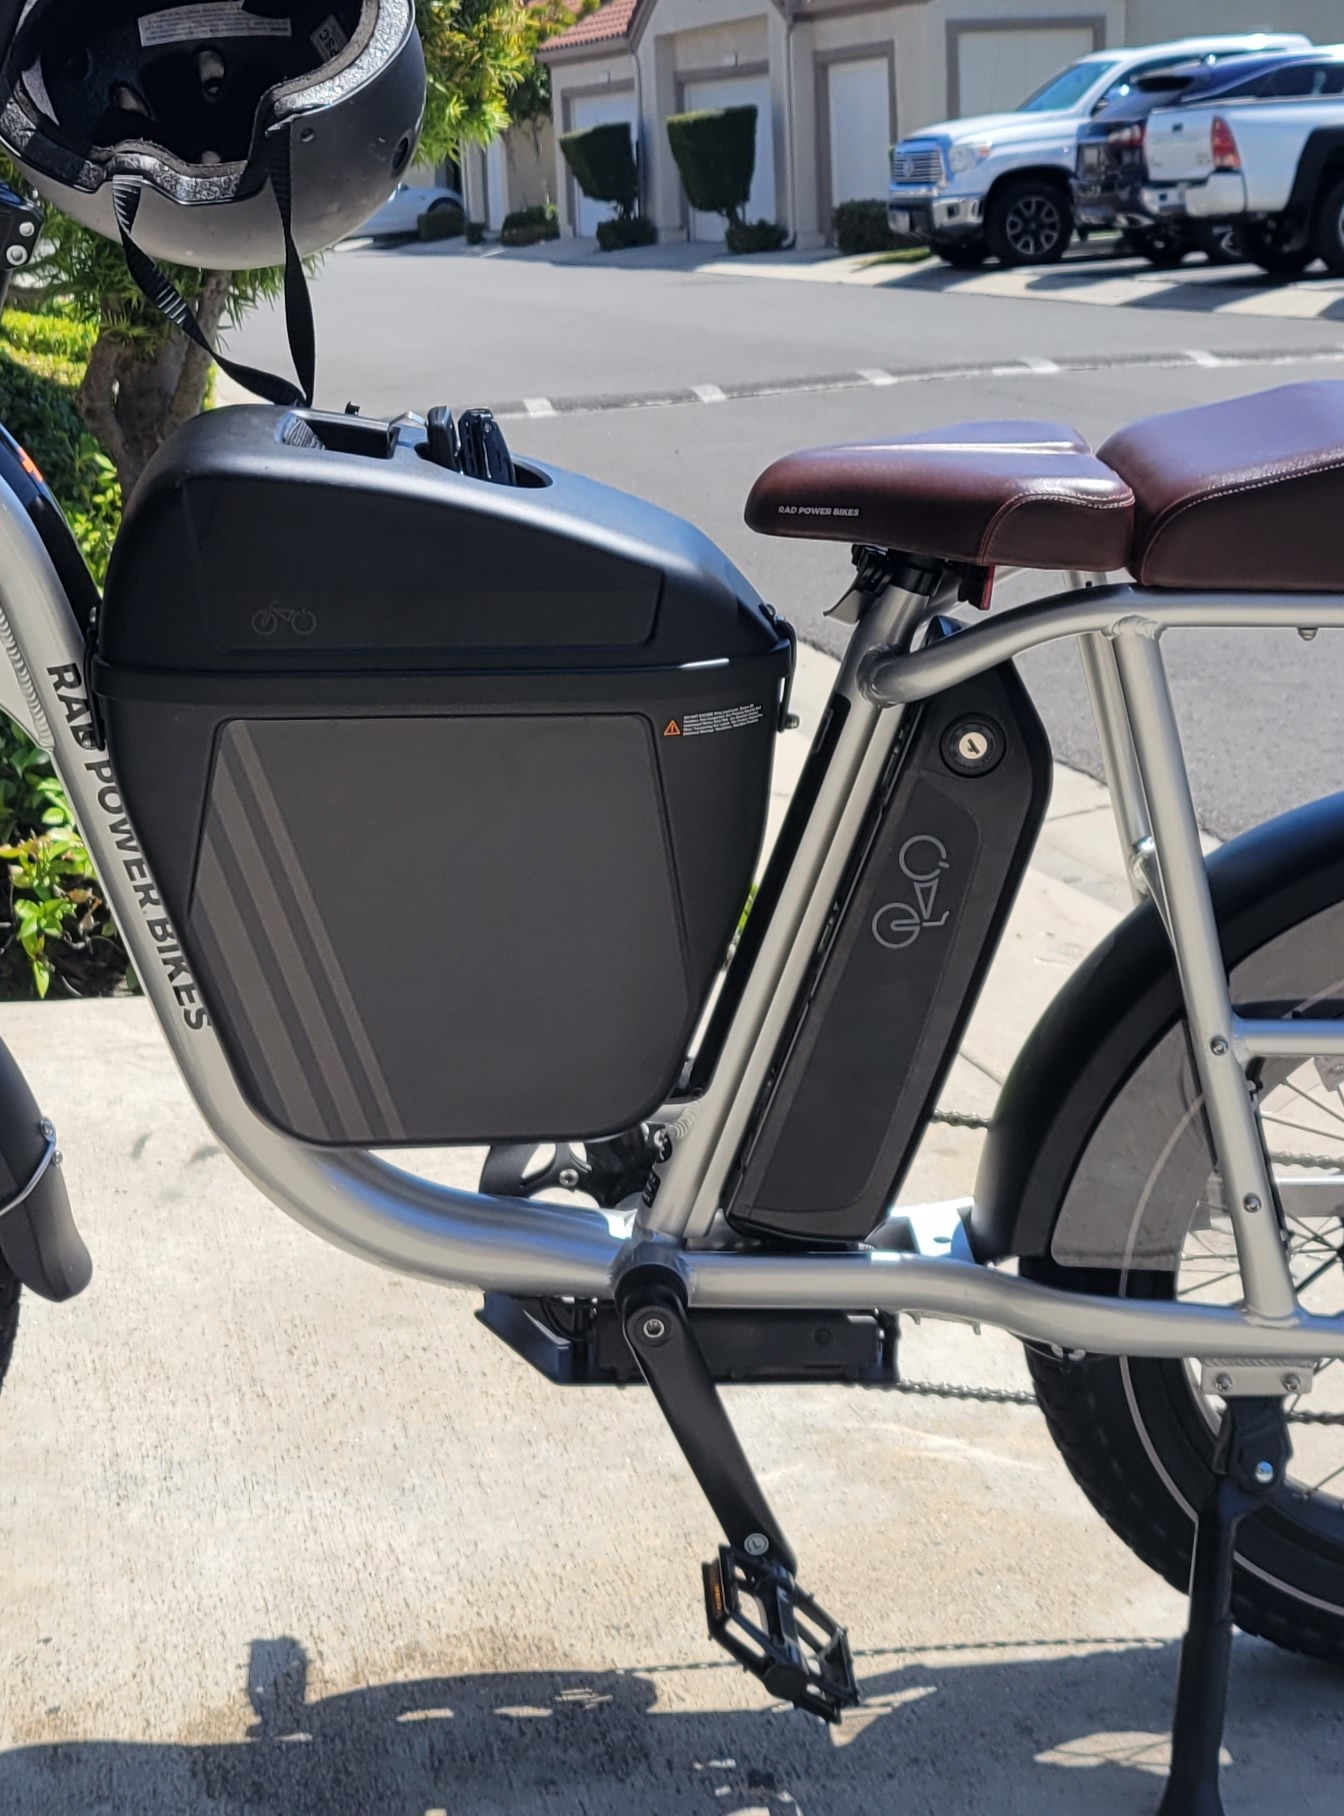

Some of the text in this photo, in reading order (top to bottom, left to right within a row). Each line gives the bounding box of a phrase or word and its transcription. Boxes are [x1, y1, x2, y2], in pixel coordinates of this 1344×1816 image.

[778, 505, 859, 517] RAD POWER BIKES
[46, 662, 212, 1031] RAD POWER BIKES
